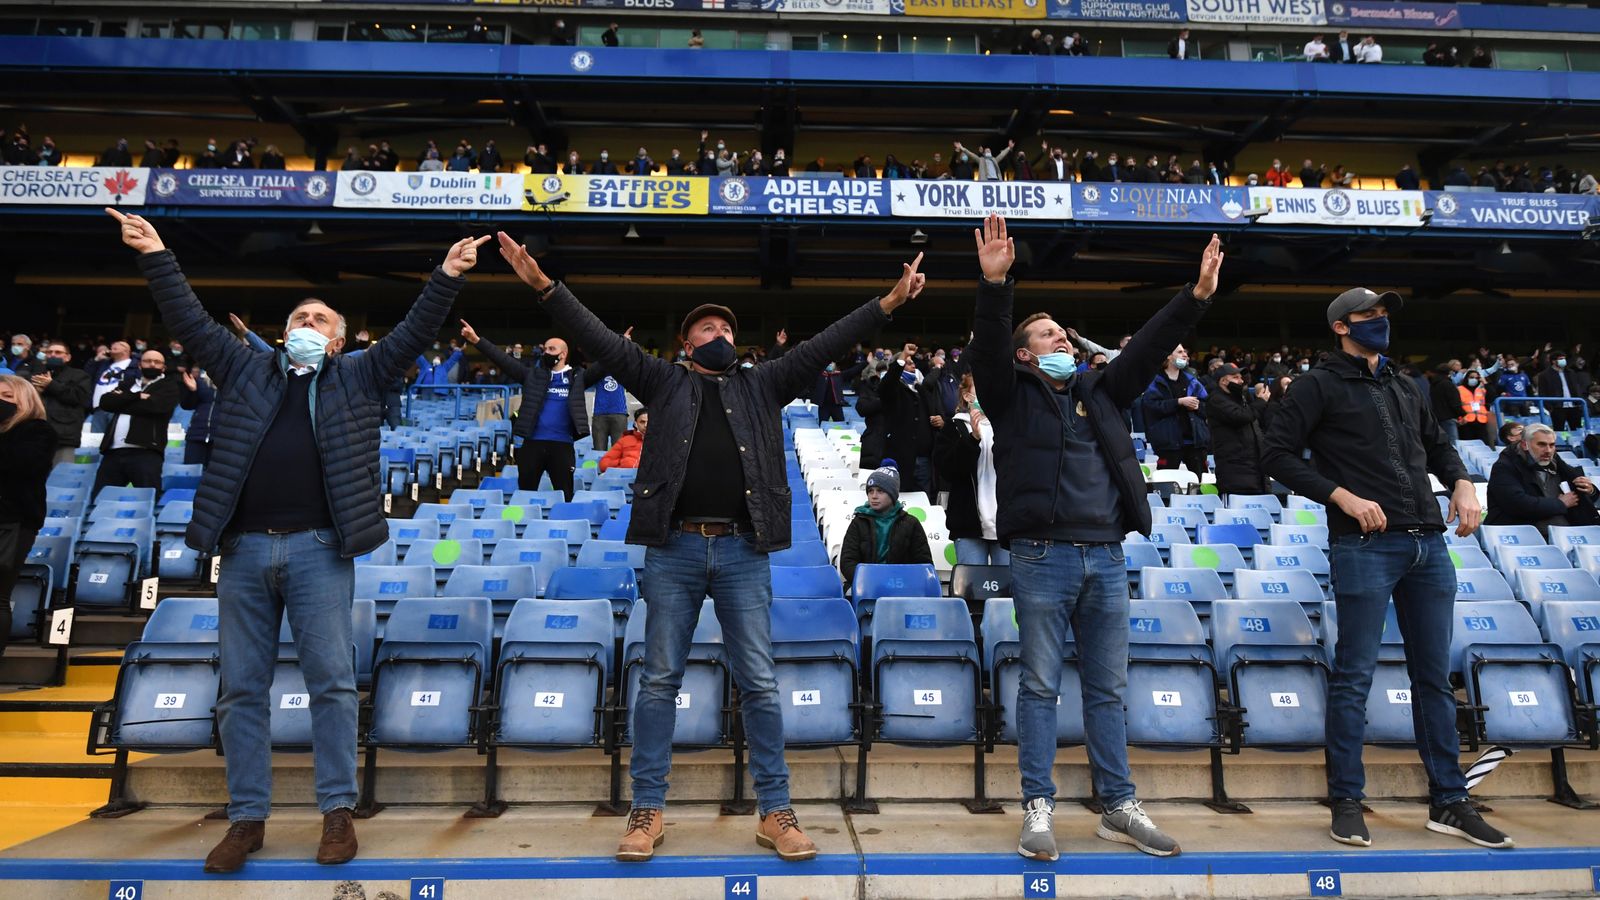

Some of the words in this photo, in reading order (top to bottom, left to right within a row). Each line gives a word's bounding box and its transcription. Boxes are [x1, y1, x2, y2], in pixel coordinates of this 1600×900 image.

[624, 0, 675, 8] BLUES
[952, 0, 1013, 9] BELFAST
[1081, 3, 1142, 11] SUPPORTERS
[1145, 3, 1170, 11] CLUB
[1190, 0, 1259, 13] SOUTH
[1268, 0, 1321, 15] WEST
[1081, 9, 1126, 18] WESTERN
[1128, 10, 1180, 19] AUSTRALIA
[3, 170, 73, 183] CHELSEA
[79, 171, 100, 183] FC
[188, 174, 246, 188] CHELSEA
[252, 175, 296, 188] ITALIA
[430, 177, 476, 189] Dublin
[588, 179, 691, 192] SAFFRON
[763, 179, 883, 197] ADELAIDE
[2, 183, 98, 198] TORONTO
[199, 189, 256, 198] SUPPORTERS
[260, 190, 282, 200] CLUB
[1110, 187, 1212, 204] SLOVENIAN
[391, 193, 474, 206] Supporters
[479, 194, 512, 205] Club
[587, 192, 692, 209] BLUES
[915, 184, 971, 207] YORK
[983, 185, 1046, 209] BLUES
[768, 198, 880, 215] CHELSEA
[1276, 199, 1317, 214] ENNIS
[1357, 200, 1401, 216] BLUES
[1501, 198, 1526, 207] TRUE
[1530, 199, 1559, 208] BLUES
[1136, 204, 1189, 219] BLUES
[1471, 208, 1591, 225] VANCOUVER
[1236, 517, 1247, 525] 51
[928, 532, 941, 541] 46
[1292, 535, 1306, 543] 51
[1502, 535, 1516, 544] 54
[1570, 535, 1584, 544] 55
[1280, 557, 1296, 566] 50
[1522, 556, 1537, 566] 53
[384, 582, 402, 594] 40
[887, 578, 904, 589] 45
[982, 581, 999, 592] 46
[1170, 583, 1186, 594] 48
[1267, 583, 1284, 594] 49
[1457, 582, 1471, 592] 51
[1544, 582, 1562, 593] 52
[147, 585, 154, 600] 5
[57, 619, 66, 635] 4
[200, 615, 219, 630] 39
[552, 616, 573, 628] 42
[909, 615, 930, 628] 45
[1136, 619, 1154, 631] 47
[1245, 619, 1265, 631] 48
[1470, 617, 1490, 630] 50
[1579, 617, 1595, 631] 51
[163, 696, 177, 706] 39
[288, 696, 302, 706] 40
[419, 693, 433, 704] 41
[543, 695, 556, 705] 42
[676, 696, 683, 706] 3
[800, 692, 813, 702] 44
[922, 692, 935, 703] 45
[1160, 694, 1173, 704] 47
[1279, 695, 1292, 705] 48
[1396, 691, 1408, 702] 49
[1517, 693, 1530, 703] 50
[1030, 878, 1049, 893] 45
[1316, 875, 1335, 890] 48
[115, 886, 137, 900] 40
[419, 884, 436, 899] 41
[731, 881, 751, 896] 44
